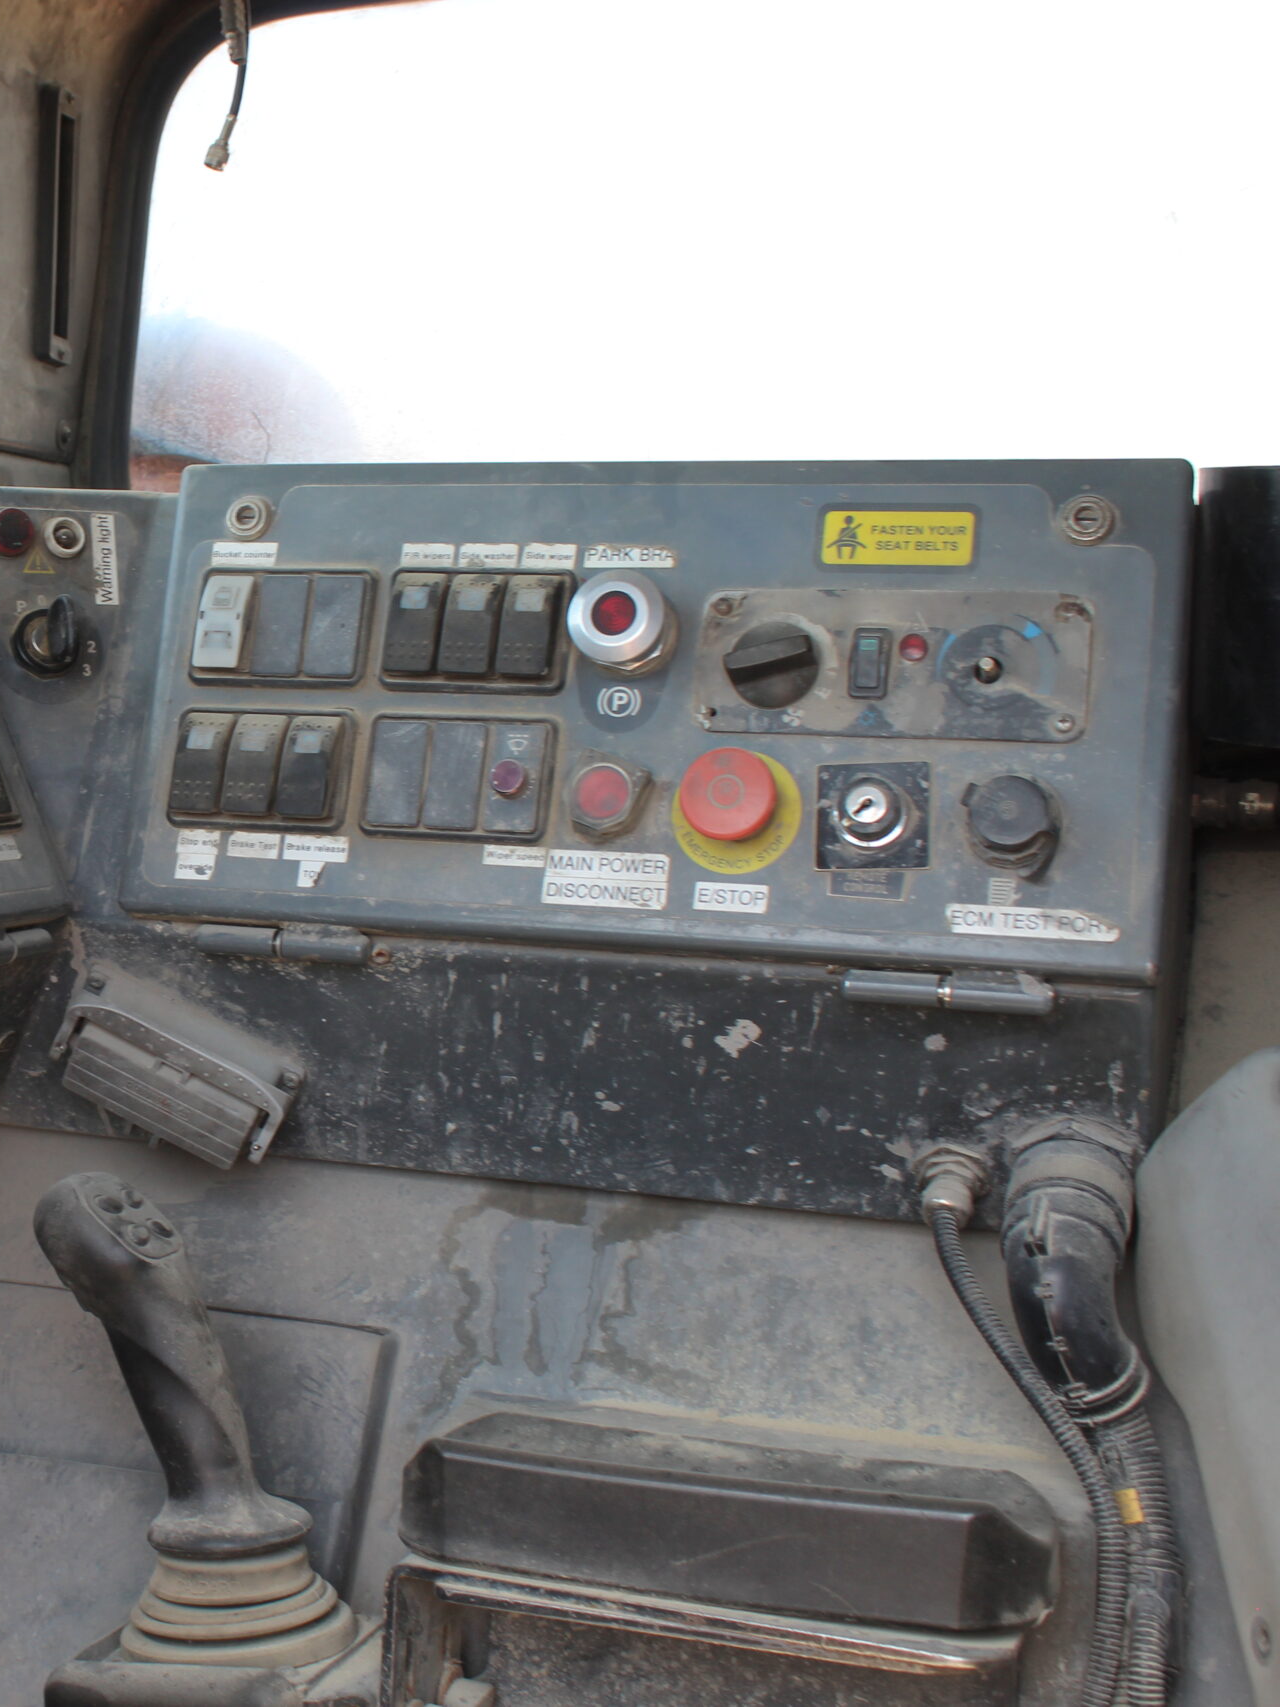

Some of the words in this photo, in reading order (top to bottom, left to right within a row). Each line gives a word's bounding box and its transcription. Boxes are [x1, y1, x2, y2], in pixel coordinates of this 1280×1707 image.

[98, 515, 109, 544] light
[871, 525, 925, 536] FASTEN
[927, 526, 967, 536] YOUR
[875, 540, 912, 551] SEAT
[914, 541, 959, 551] BELTS
[244, 551, 276, 559] counter
[421, 552, 452, 562] wipers
[459, 551, 480, 560] Side
[482, 552, 517, 560] washer
[525, 551, 546, 560] Side
[548, 552, 575, 562] wiper
[587, 547, 634, 562] PARK
[100, 547, 114, 603] Warning
[87, 640, 96, 654] 2
[82, 664, 92, 676] 3
[230, 840, 255, 848] Brake
[257, 842, 277, 850] Test
[286, 843, 310, 852] Brake
[314, 844, 346, 854] release
[548, 856, 593, 871] MAIN
[598, 857, 666, 874] POWER
[546, 882, 666, 903] DISCONNECT
[698, 888, 766, 906] E/STOP
[952, 910, 994, 928] ECM
[999, 912, 1052, 930] TEST
